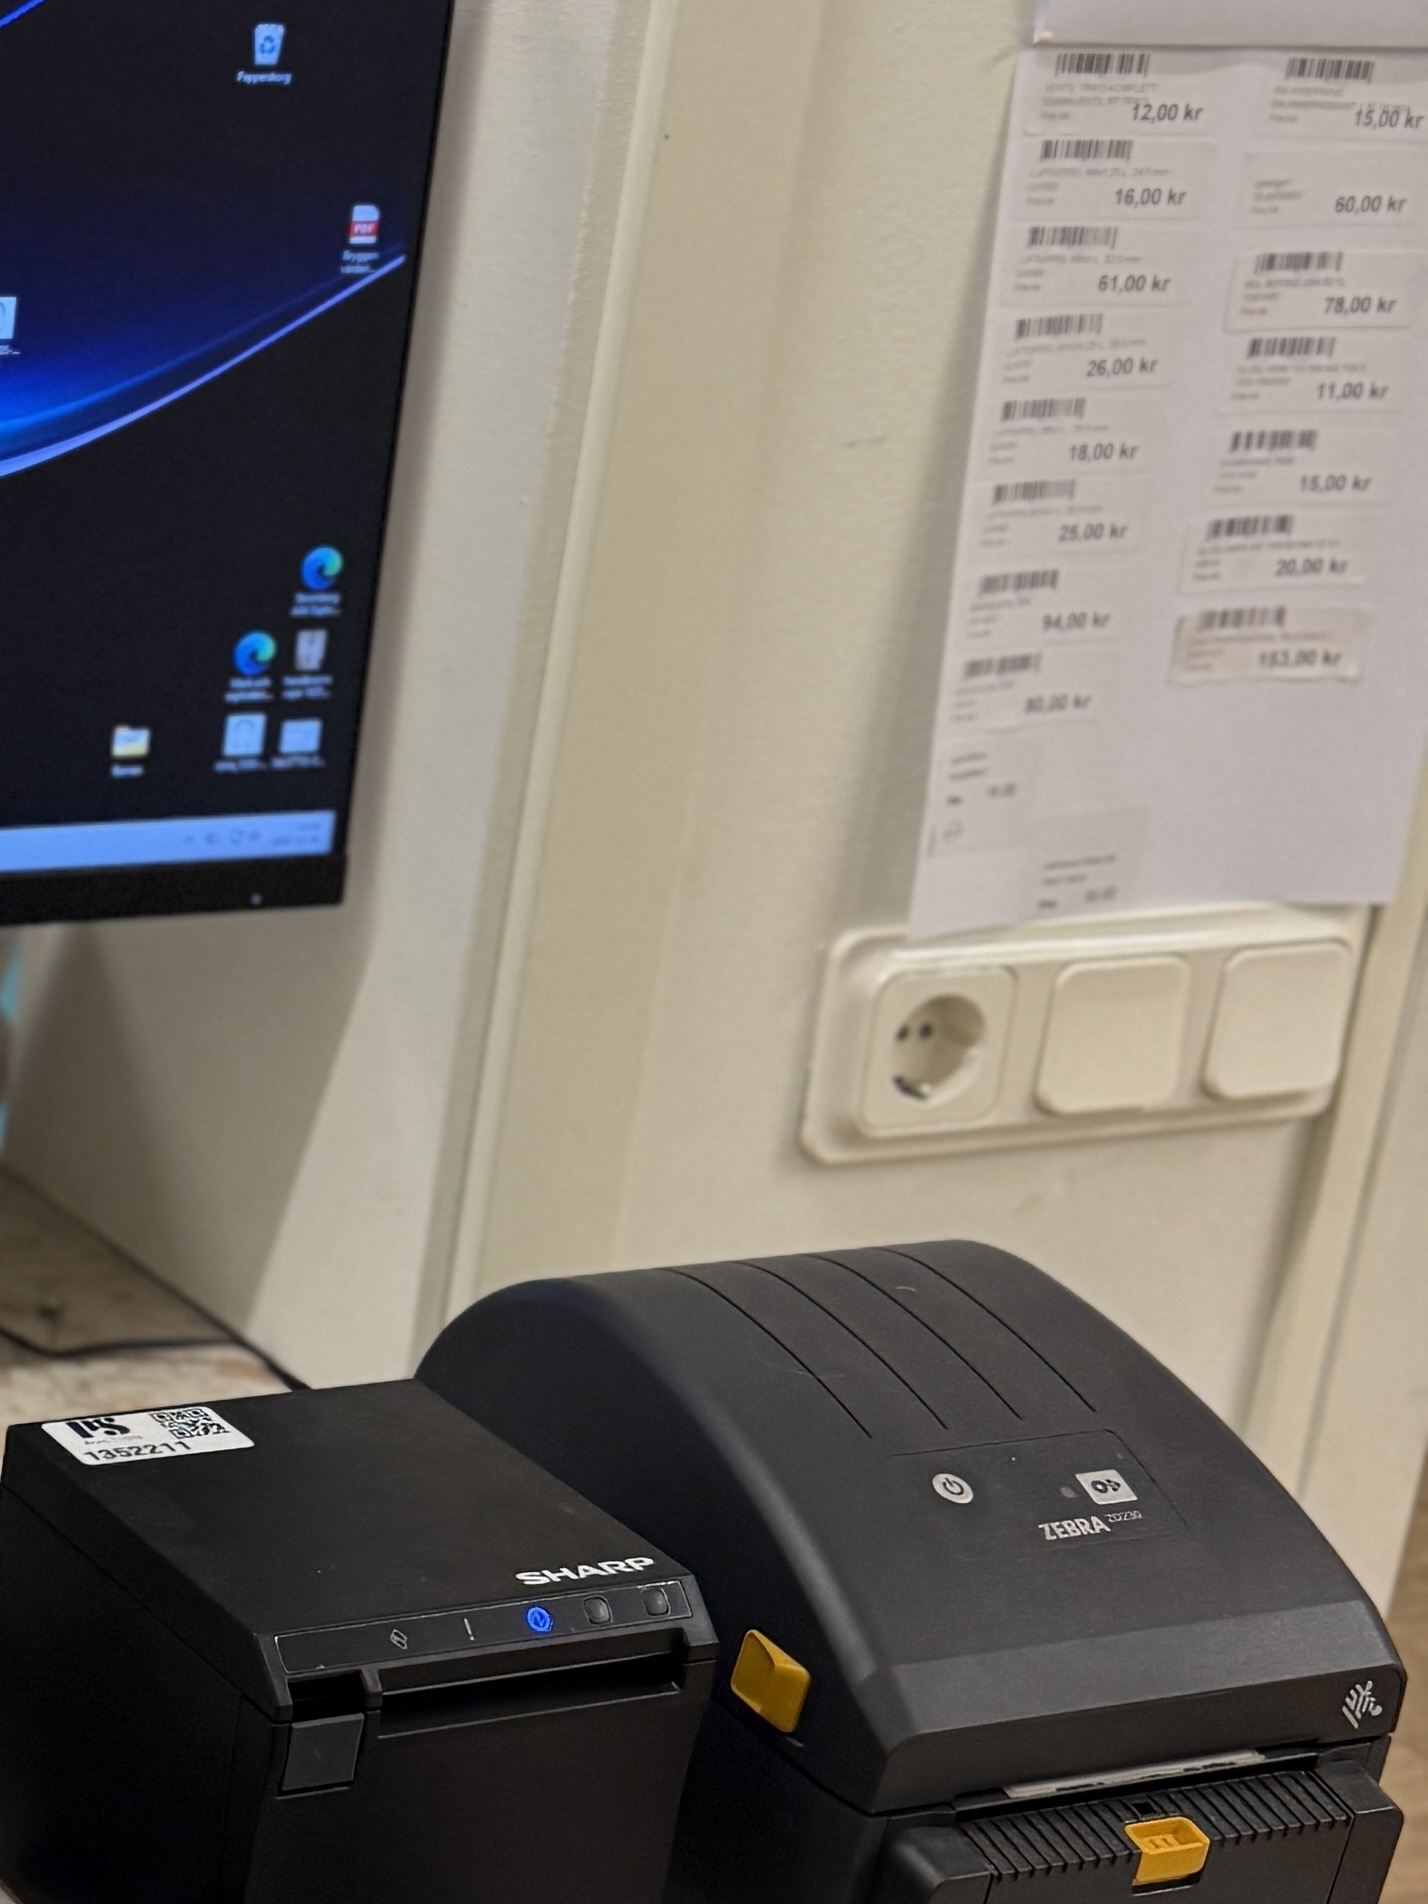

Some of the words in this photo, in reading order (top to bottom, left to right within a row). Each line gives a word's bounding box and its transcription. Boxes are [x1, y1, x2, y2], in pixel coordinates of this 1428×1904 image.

[1131, 102, 1179, 124] 12,00
[1183, 103, 1204, 121] kr
[1353, 108, 1400, 130] 15,00
[1404, 110, 1424, 129] kr
[1114, 187, 1162, 208] 16,00
[1167, 188, 1187, 206] kr
[1387, 196, 1408, 213] kr
[1097, 275, 1146, 294] 61,00
[1150, 275, 1171, 292] kr
[1323, 295, 1372, 316] 78,00
[1377, 296, 1397, 314] kr
[1138, 358, 1159, 375] kr
[1368, 382, 1390, 400] kr
[1119, 443, 1139, 461] kr
[1298, 474, 1347, 494] 15,00
[1351, 474, 1373, 492] kr
[1109, 523, 1128, 540] kr
[1328, 557, 1348, 576] kr
[83, 1441, 192, 1461] 1352211
[1037, 1516, 1111, 1541] ZEBRA
[515, 1556, 656, 1587] SHARP
